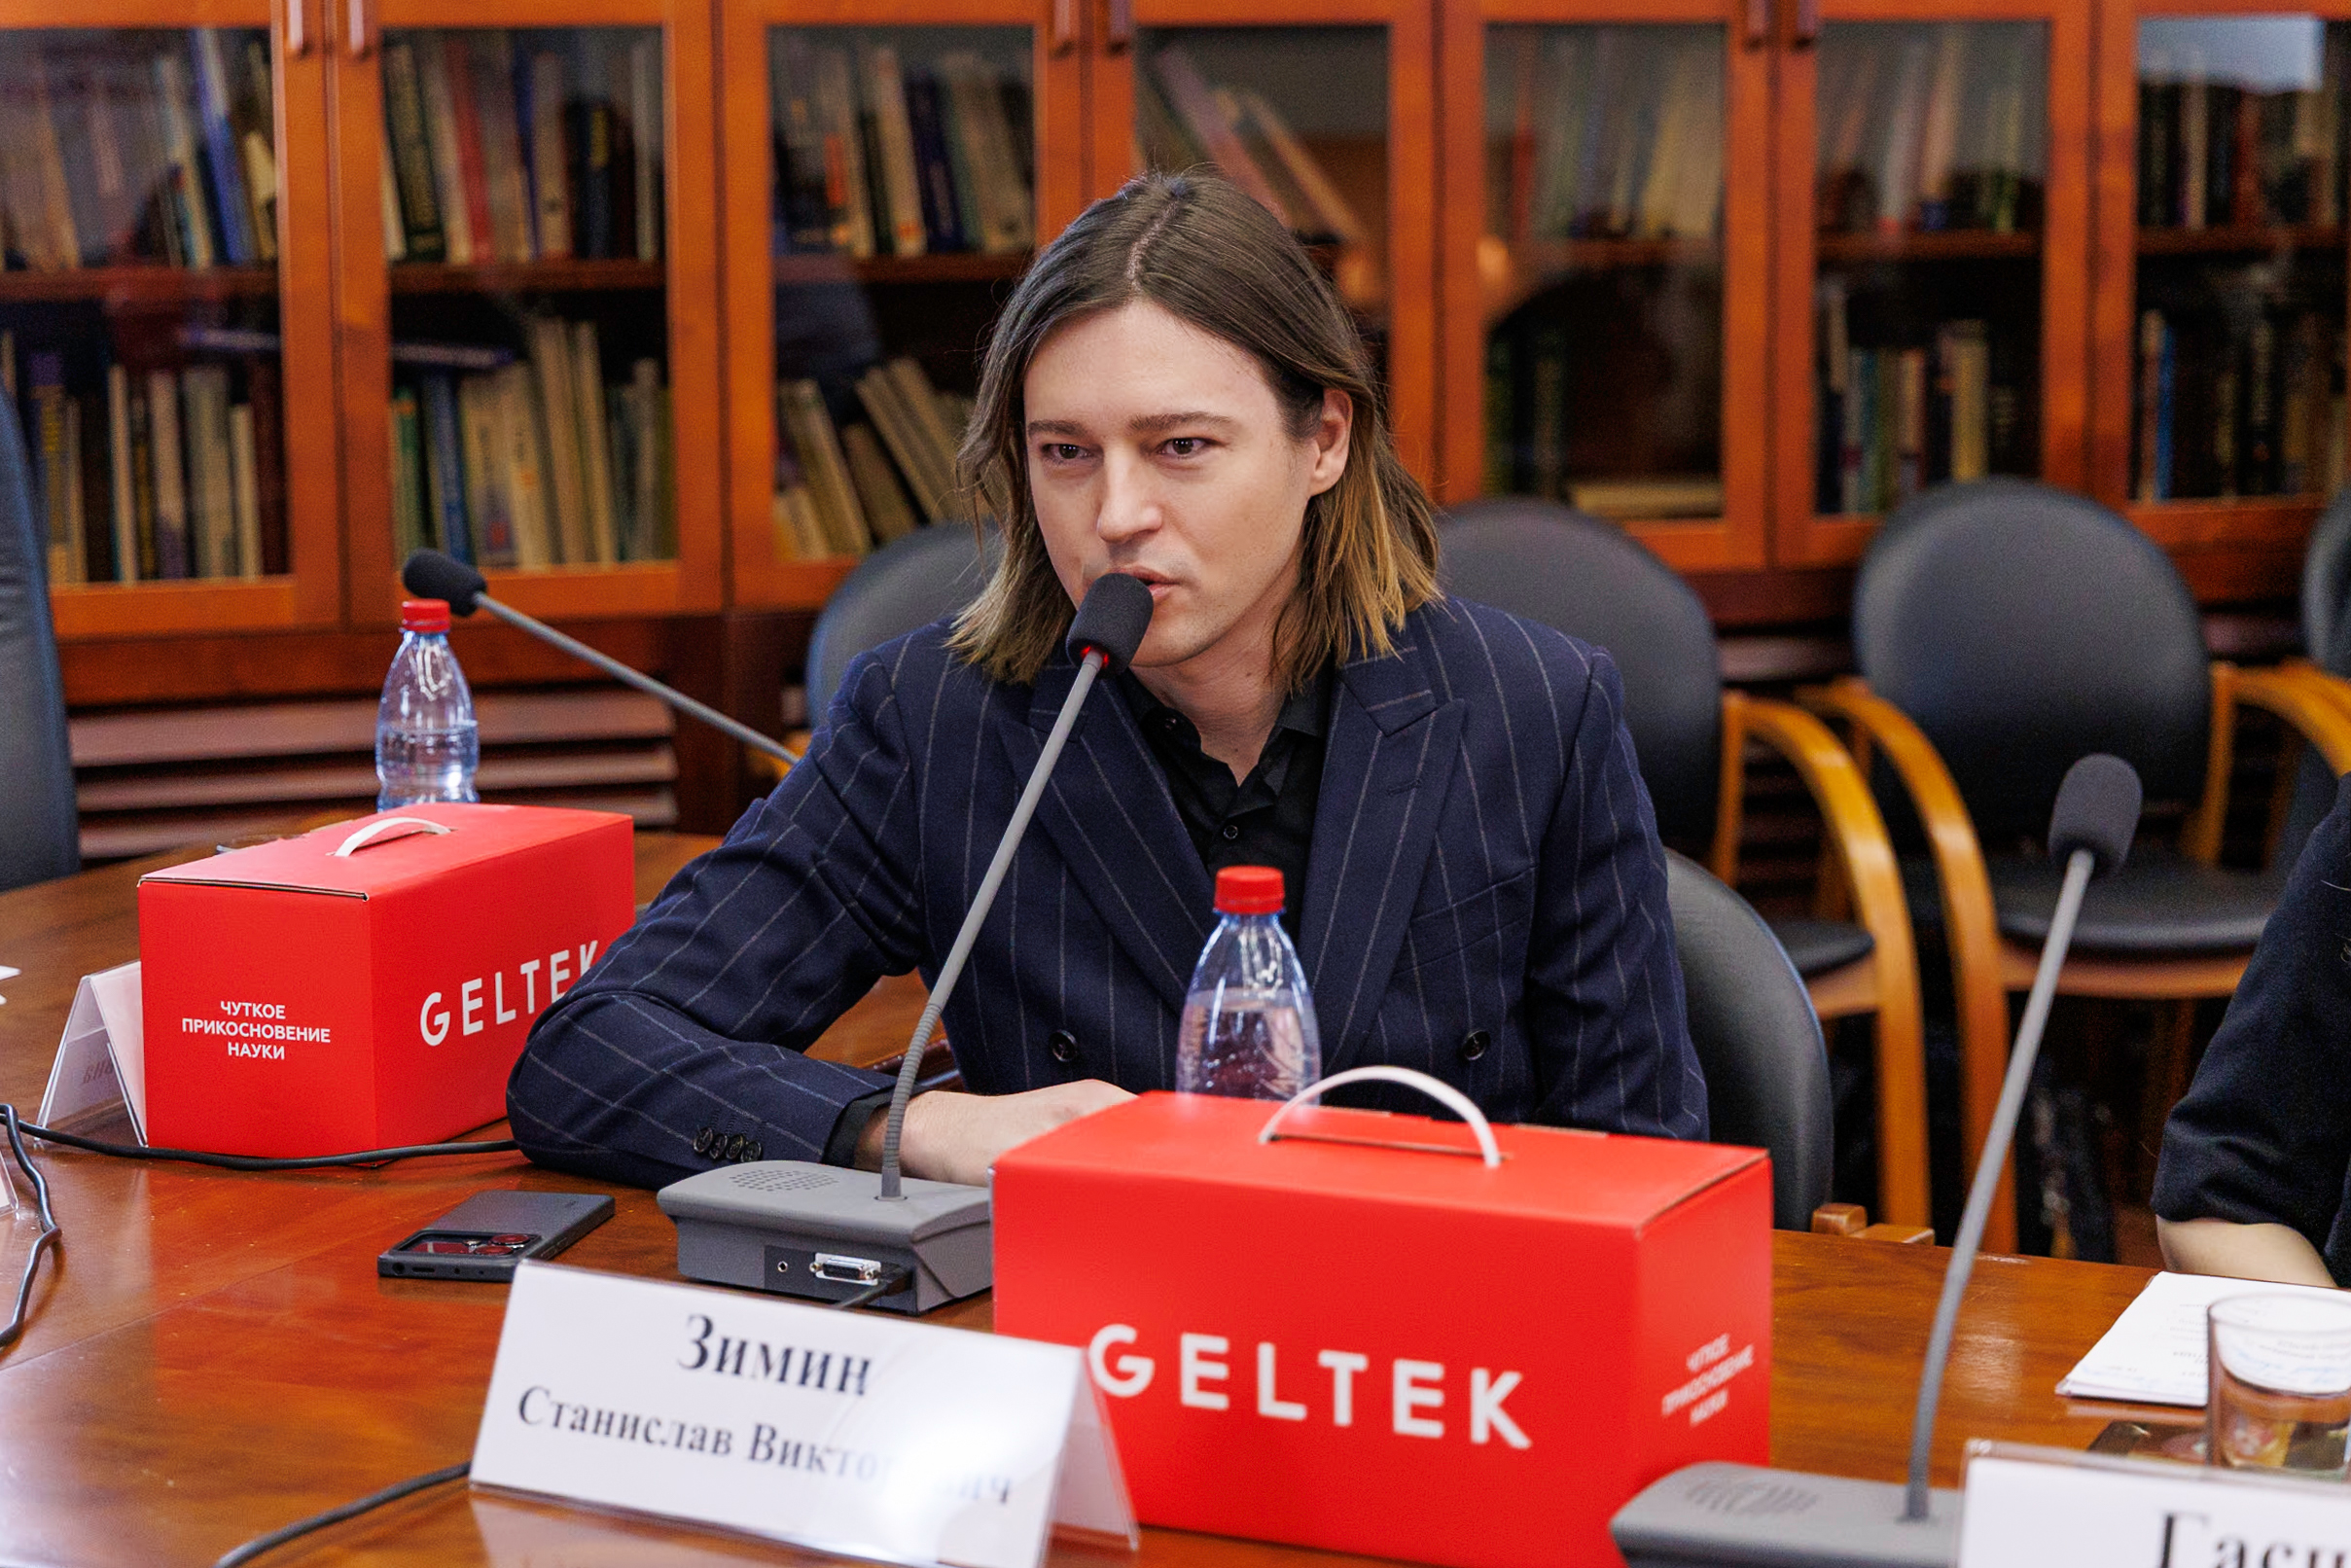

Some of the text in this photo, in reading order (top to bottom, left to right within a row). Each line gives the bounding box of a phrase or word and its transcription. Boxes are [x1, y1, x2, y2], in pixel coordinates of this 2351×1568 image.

[182, 1017, 331, 1043] ПРИКОСНОВЕНИЕ
[220, 1000, 286, 1019] ЧУТКОЕ
[228, 1042, 285, 1060] НАУКИ
[677, 1313, 873, 1396] Зимин
[1088, 1323, 1532, 1449] GELTEK
[517, 1385, 732, 1455] Станислав
